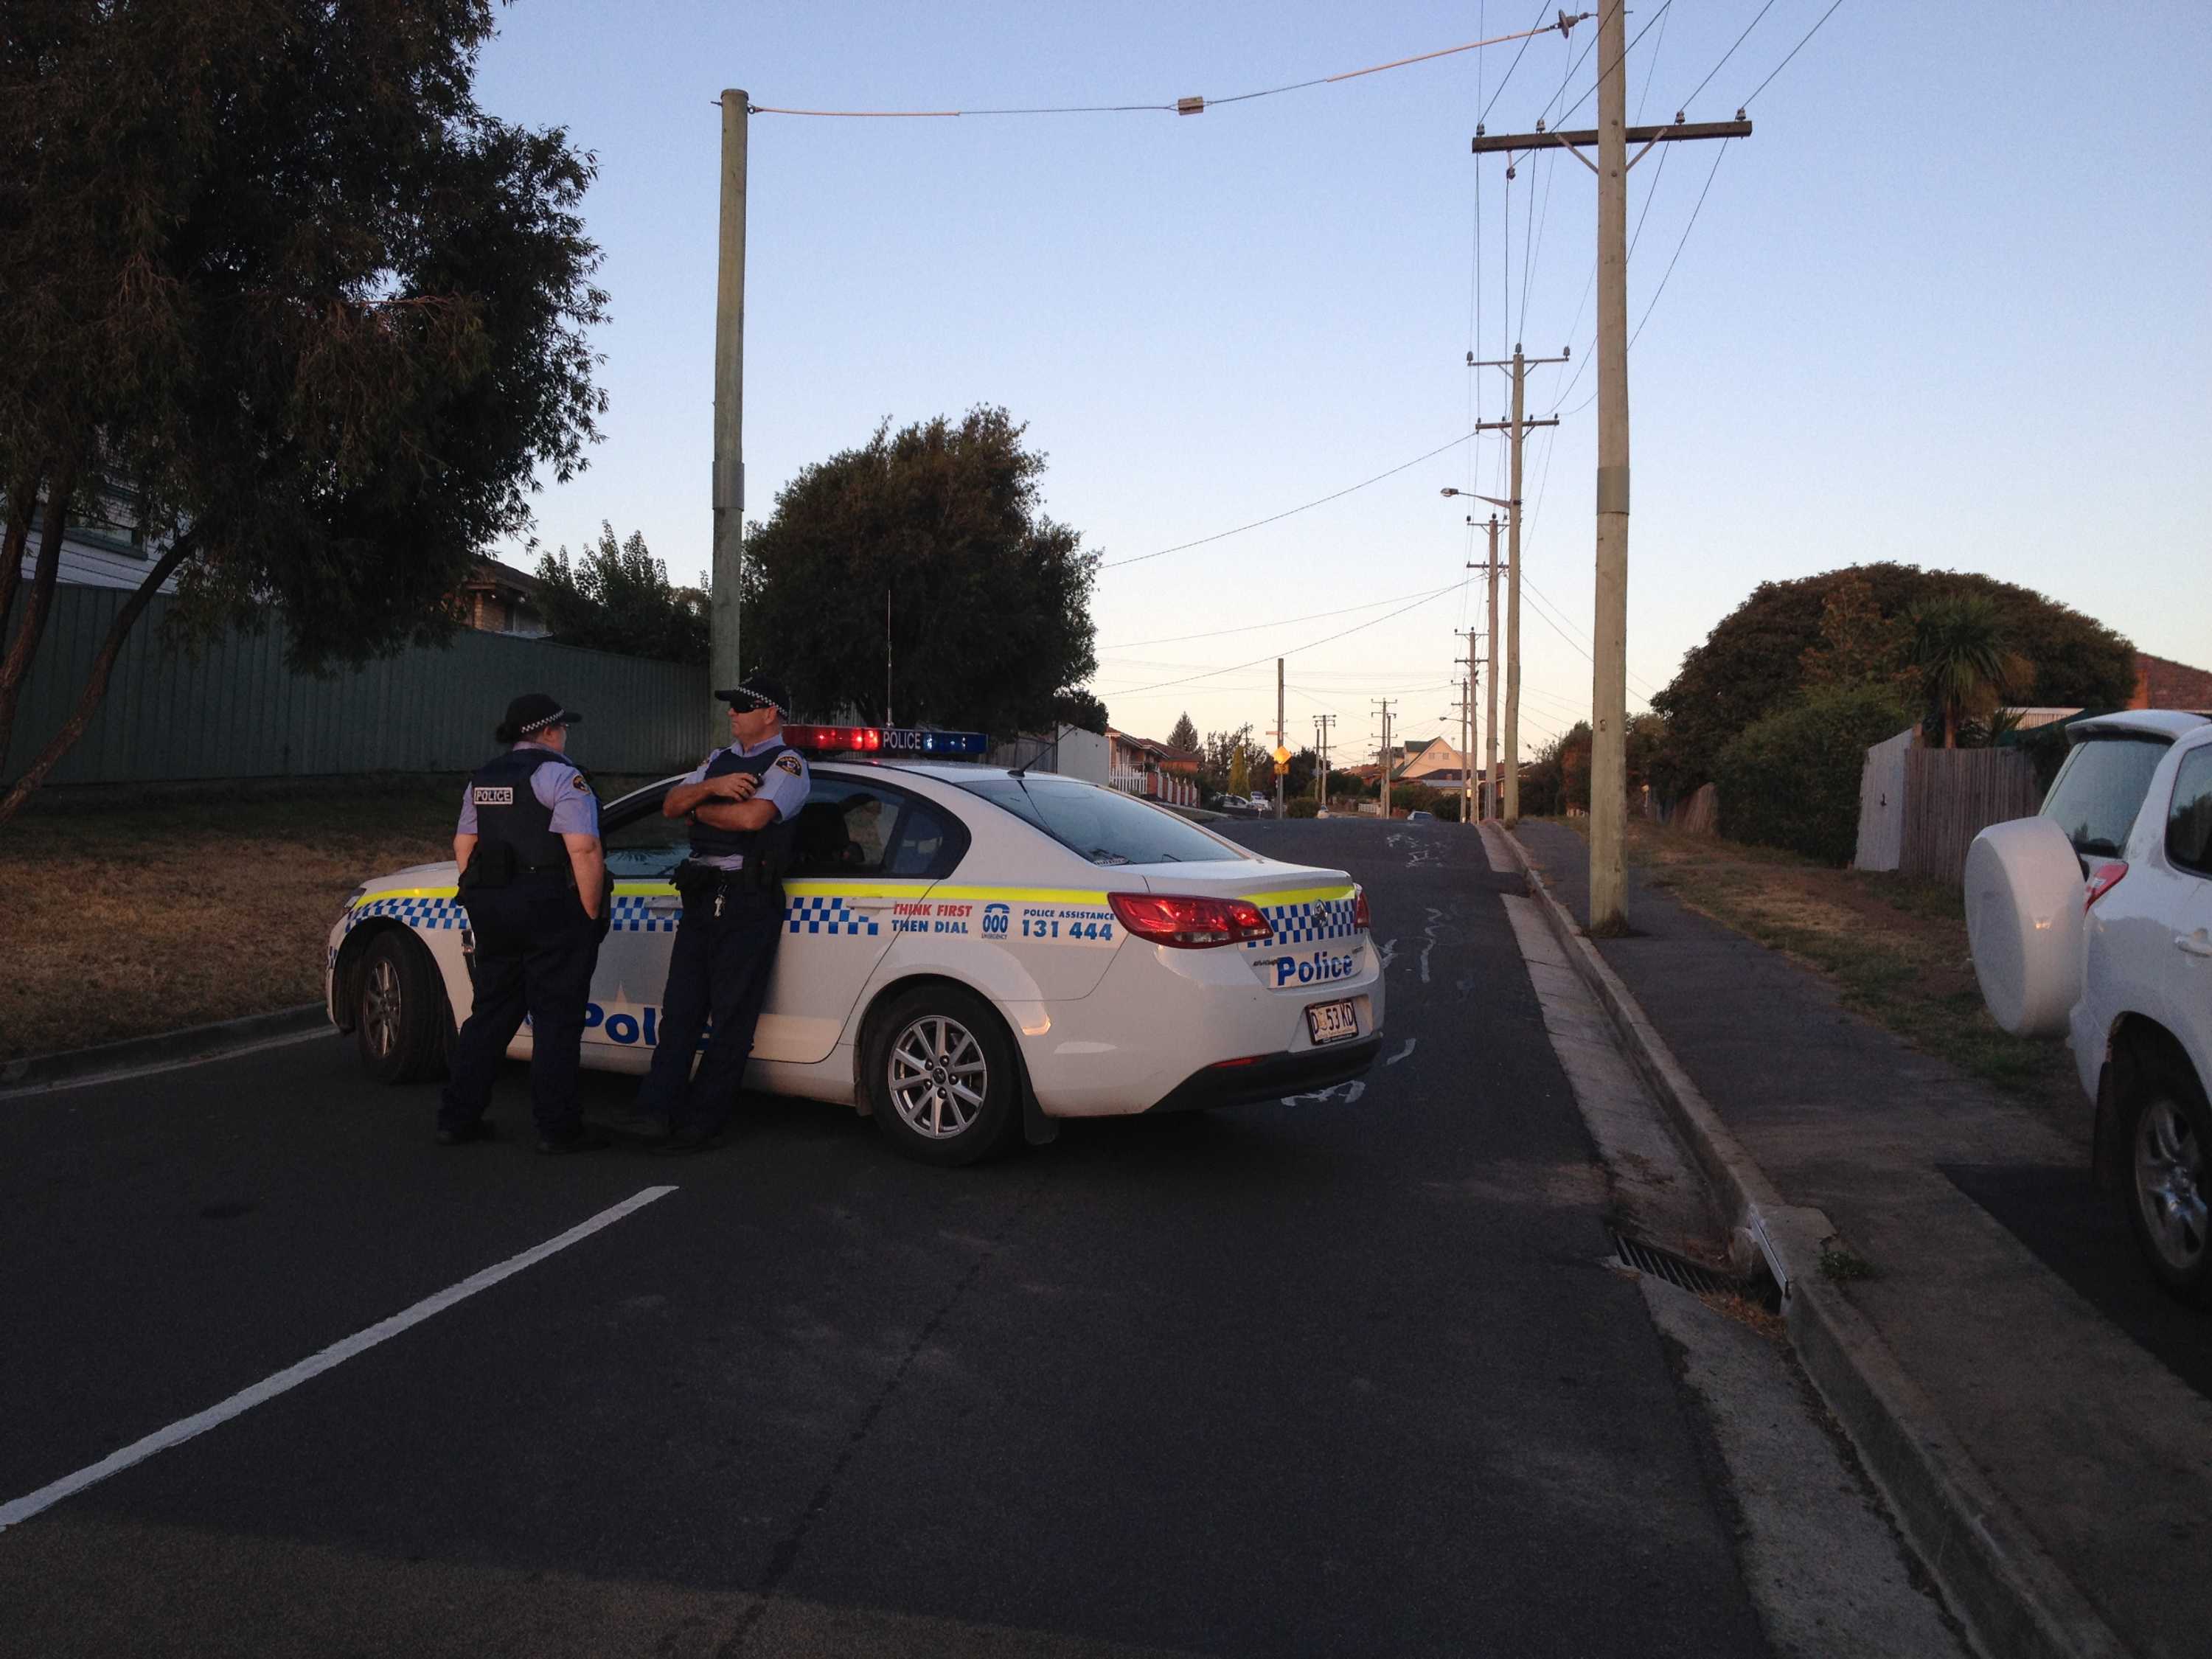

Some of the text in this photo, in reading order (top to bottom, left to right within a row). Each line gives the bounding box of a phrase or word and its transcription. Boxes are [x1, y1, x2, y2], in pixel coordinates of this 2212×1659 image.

[883, 731, 921, 749] POLICE
[476, 790, 511, 801] POLICE
[893, 903, 973, 917] THINK FIRST
[1023, 909, 1115, 920] POLICE ASSISTANCE
[891, 919, 968, 933] THEN DIAL
[983, 914, 1008, 933] 000
[1023, 919, 1113, 941] 131 444
[1277, 951, 1352, 986] Police
[584, 1002, 664, 1046] Pol
